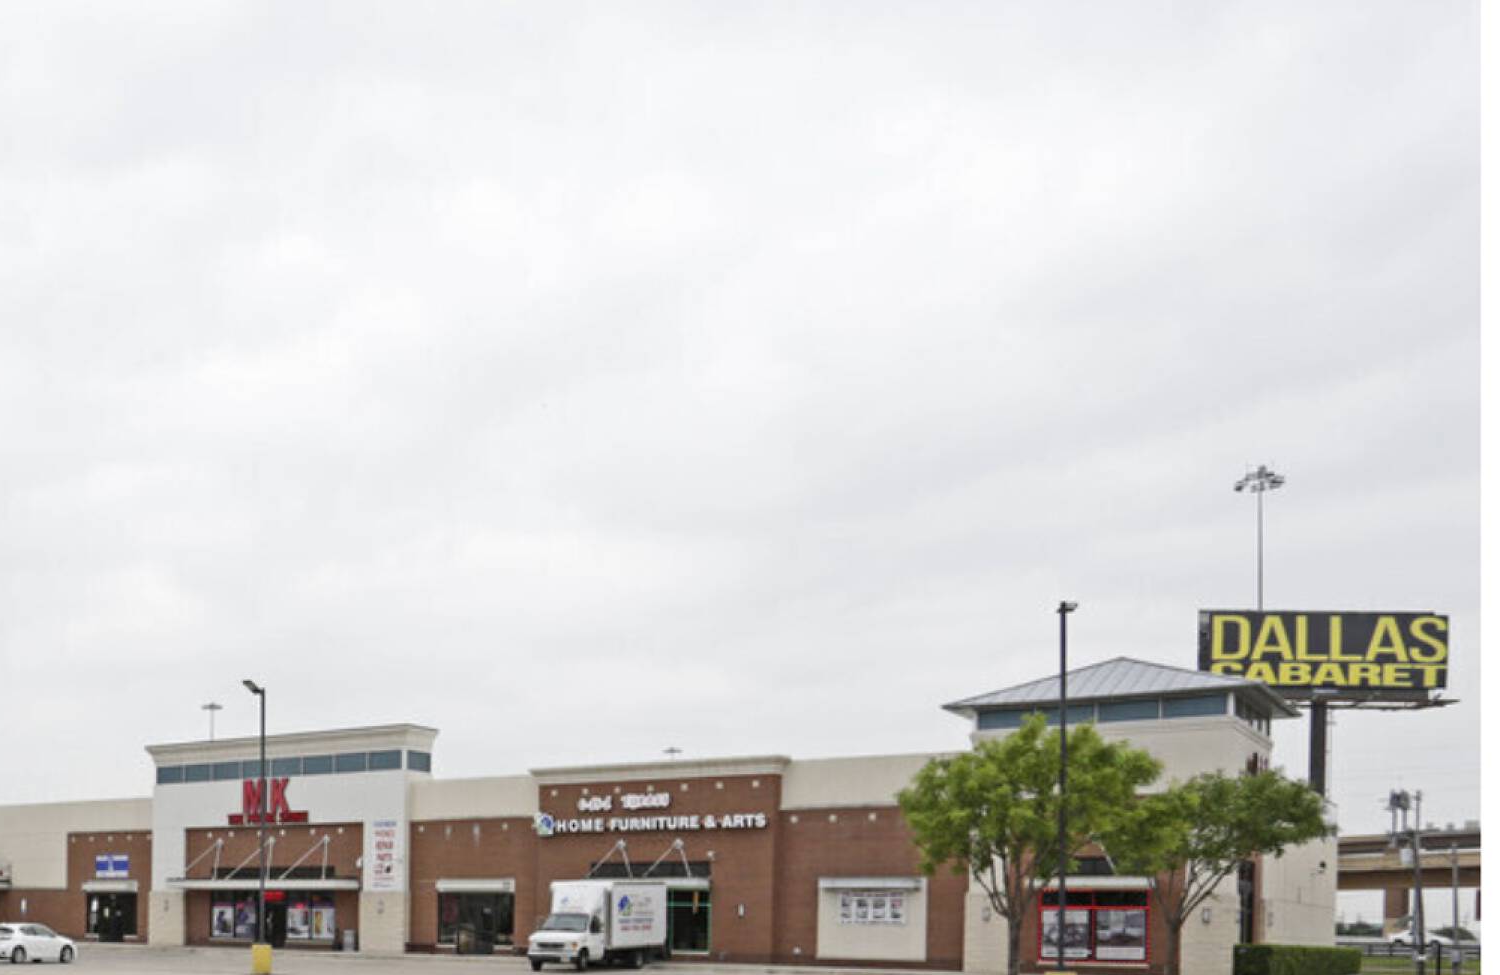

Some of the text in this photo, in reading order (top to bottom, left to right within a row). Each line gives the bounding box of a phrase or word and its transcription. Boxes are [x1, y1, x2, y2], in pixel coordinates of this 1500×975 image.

[1211, 614, 1448, 663] DALLAS
[1211, 661, 1448, 688] CABARET
[242, 775, 290, 820] MK
[556, 811, 767, 833] HOME FURNITURE & ARTS
